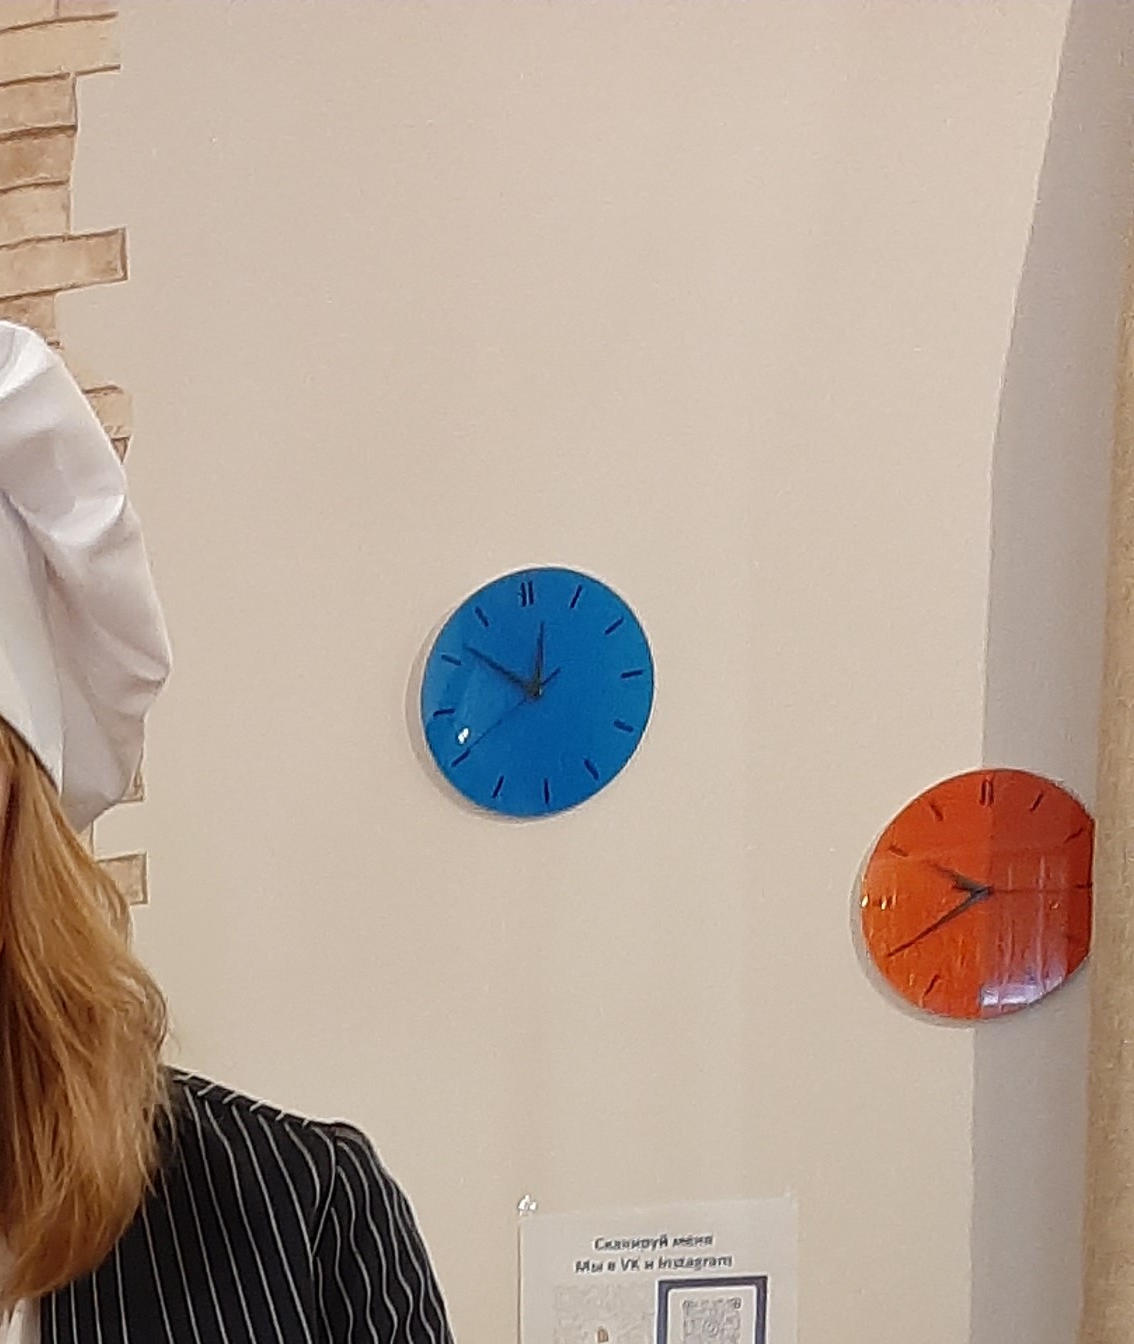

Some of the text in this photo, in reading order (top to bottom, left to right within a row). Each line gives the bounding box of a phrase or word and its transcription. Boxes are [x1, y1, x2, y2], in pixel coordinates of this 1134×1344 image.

[594, 1233, 714, 1251] Сканируй меня
[574, 1254, 733, 1274] Мы в VK и Instagram
